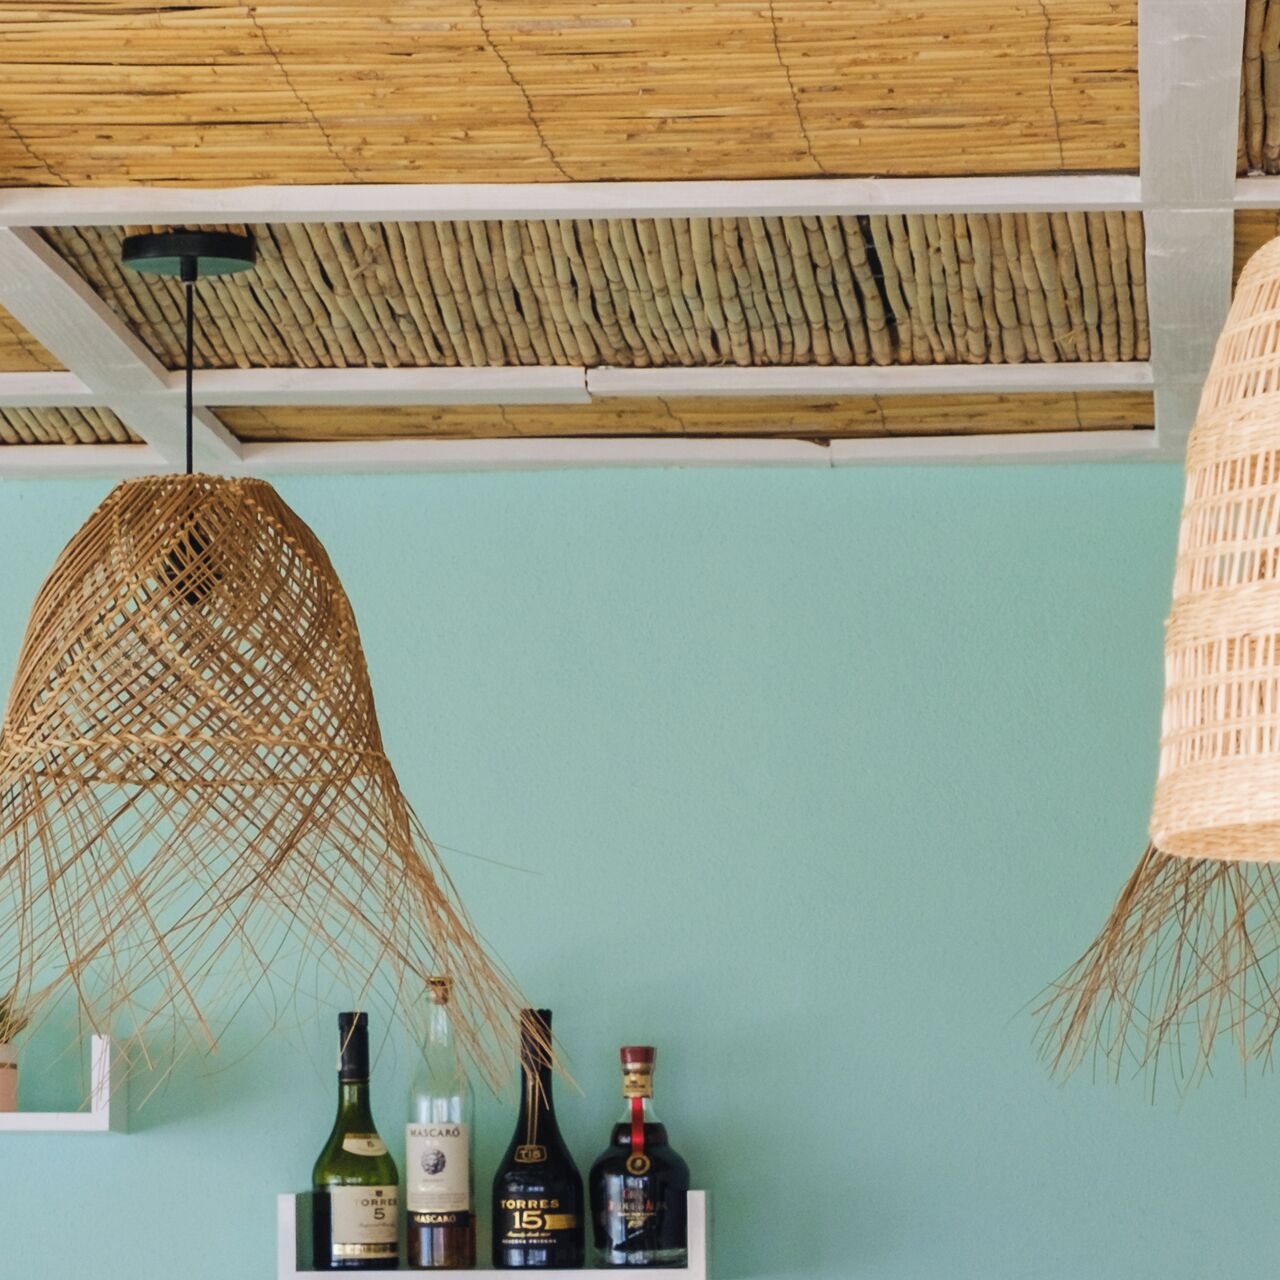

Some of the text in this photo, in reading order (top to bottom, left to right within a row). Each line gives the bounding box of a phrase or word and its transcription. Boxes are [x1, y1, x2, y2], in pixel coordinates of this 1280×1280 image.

[501, 1199, 560, 1210] TORRES
[373, 1207, 386, 1220] 5
[512, 1210, 543, 1230] 15
